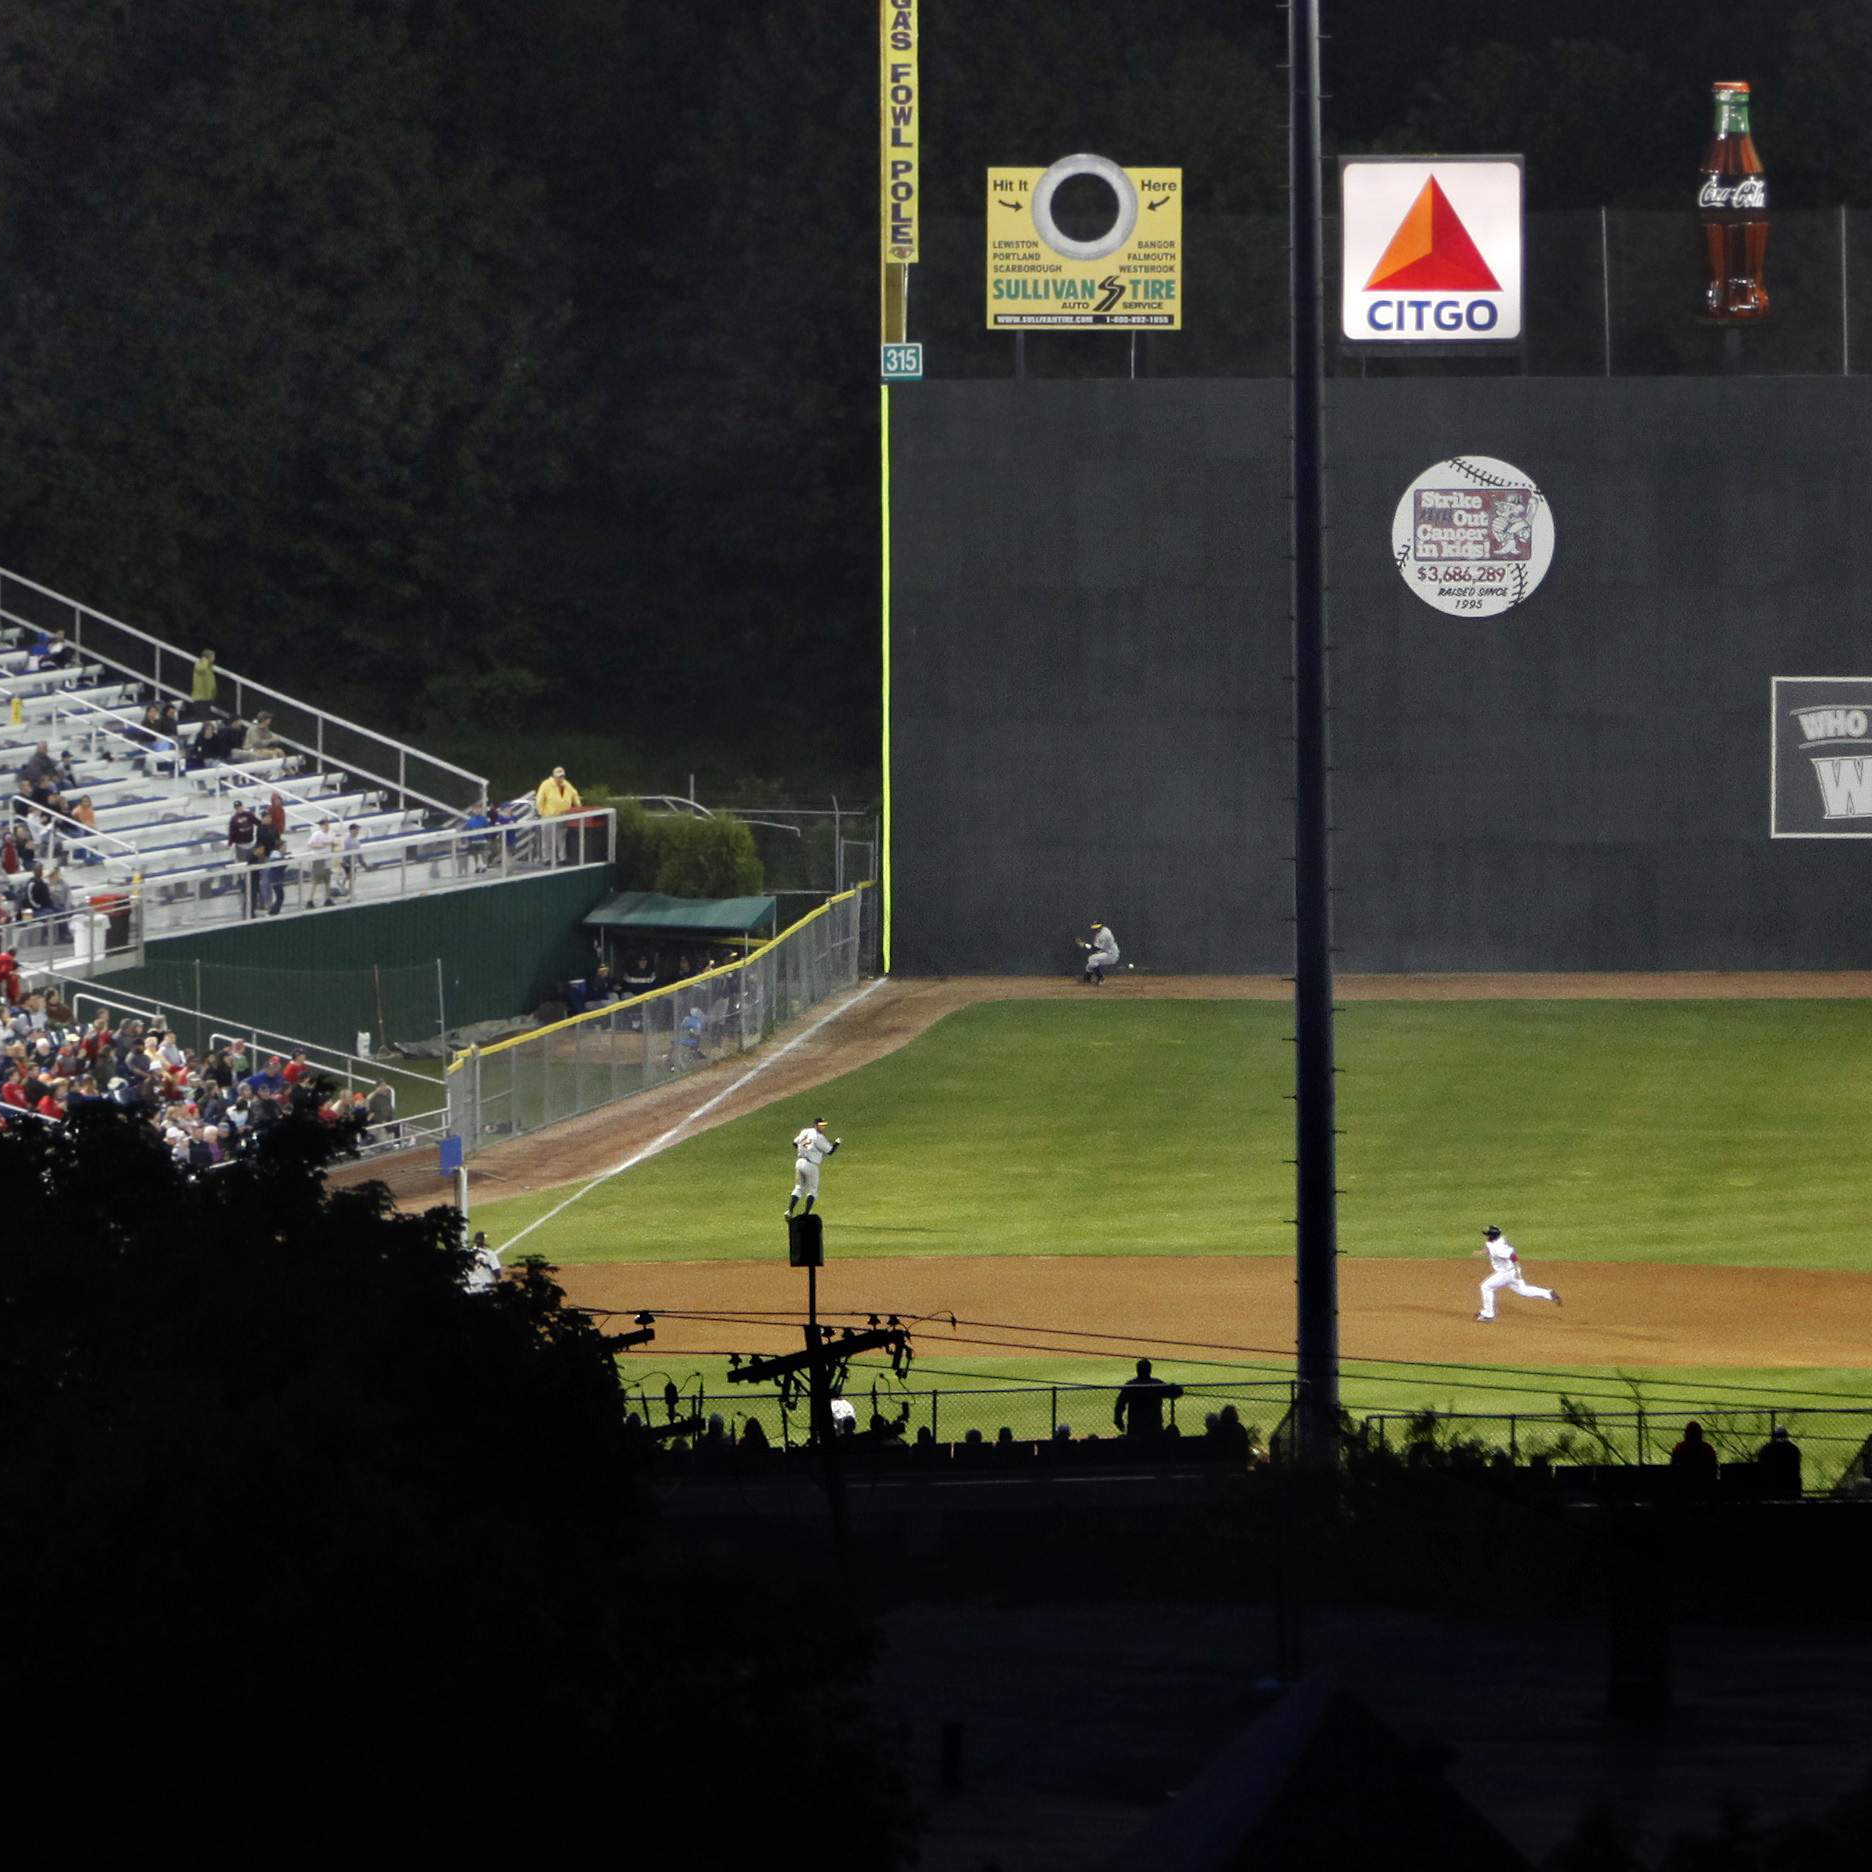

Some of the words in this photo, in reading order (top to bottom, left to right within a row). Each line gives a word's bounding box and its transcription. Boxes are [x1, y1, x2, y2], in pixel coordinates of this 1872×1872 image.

[891, 64, 913, 147] FOWL
[993, 180, 1013, 192] Hit
[1019, 180, 1028, 192] It
[1140, 180, 1177, 192] Here
[891, 161, 913, 244] POLE
[993, 241, 1038, 249] LEWISTON
[1137, 241, 1175, 249] BANGOR
[993, 253, 1040, 261] PORTLAND
[1127, 253, 1176, 261] FALMOUTH
[993, 264, 1062, 273] SCARBOROUGH
[1119, 265, 1175, 273] WESTBROOK
[992, 279, 1096, 300] SULLIVAN
[1129, 279, 1176, 299] TIRE
[1367, 299, 1498, 331] CITGO
[887, 348, 917, 372] 315
[1421, 491, 1482, 509] Strike
[1452, 510, 1489, 527] Out
[1416, 524, 1488, 541] Cancer
[1437, 587, 1476, 597] RAISED
[1478, 587, 1508, 597] SINCE
[1797, 710, 1866, 740] WHO
